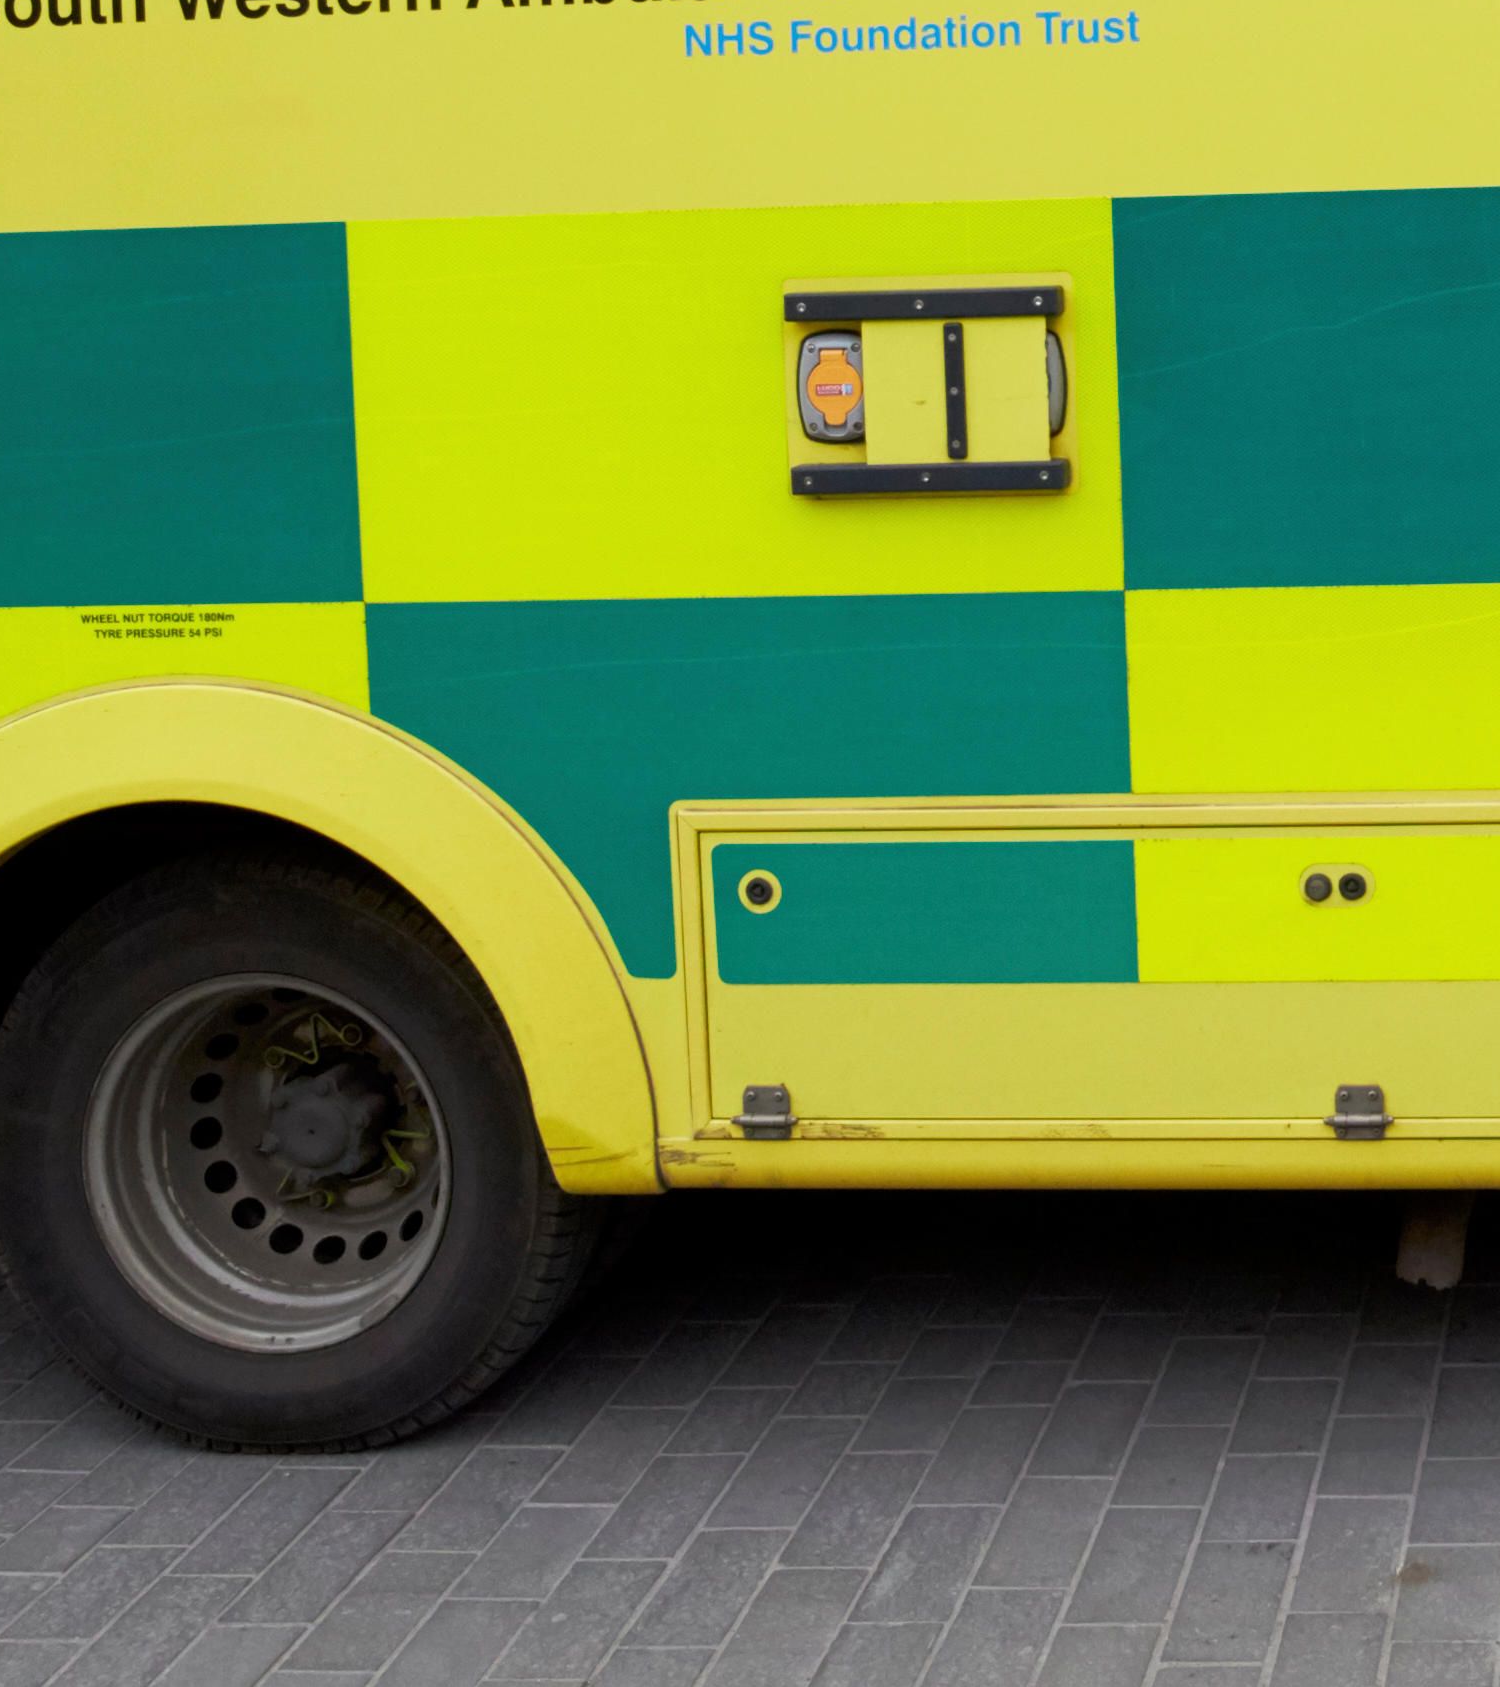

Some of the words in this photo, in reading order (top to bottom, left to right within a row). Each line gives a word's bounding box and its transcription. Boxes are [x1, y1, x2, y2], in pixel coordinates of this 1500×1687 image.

[685, 21, 774, 57] NHS
[791, 16, 1020, 53] Foundation
[1037, 11, 1140, 46] Trust
[81, 614, 120, 624] WHEEL
[123, 613, 145, 623] NUT
[148, 612, 195, 623] TORQUE
[199, 612, 235, 622] 180Nm
[94, 629, 123, 639] TYRE
[126, 628, 186, 638] PRESSURE
[189, 628, 202, 638] 54
[204, 627, 223, 637] PSI
